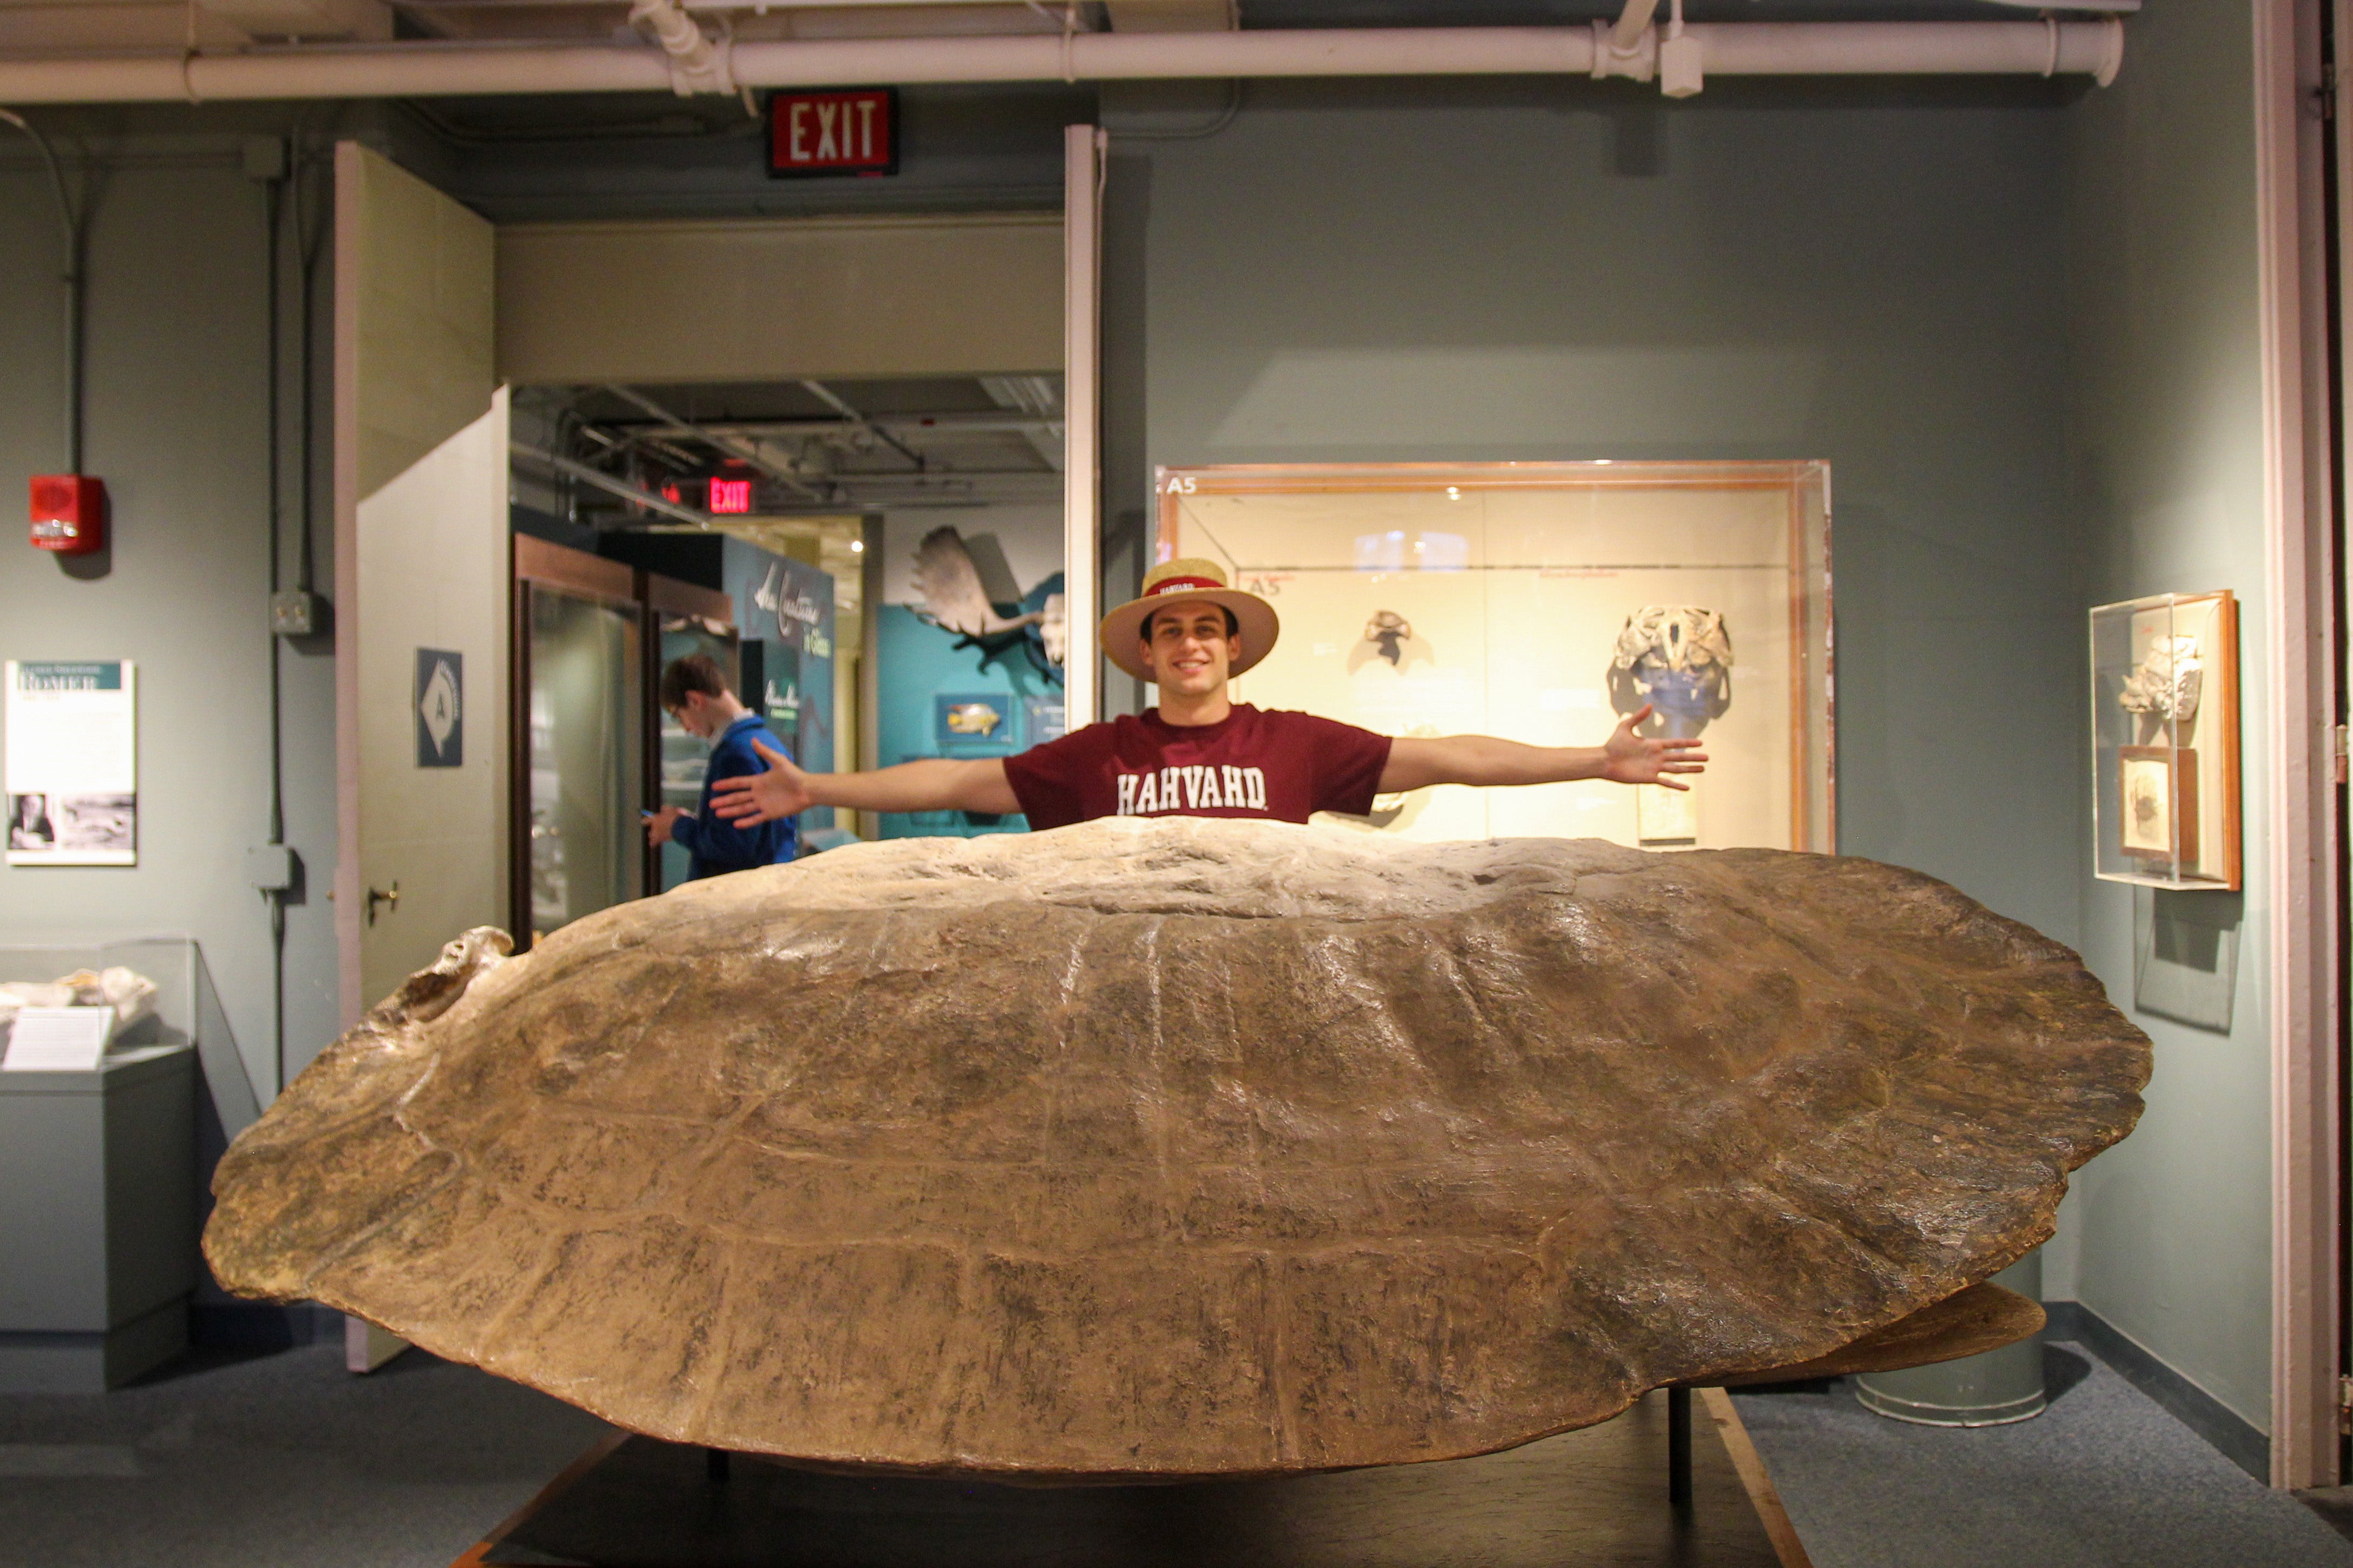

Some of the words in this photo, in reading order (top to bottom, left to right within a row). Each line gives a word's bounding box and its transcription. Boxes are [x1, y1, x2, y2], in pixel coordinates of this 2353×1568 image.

[790, 100, 877, 161] EXIT
[710, 477, 750, 513] EXIT
[1167, 477, 1196, 494] A5
[1159, 582, 1195, 595] HARVARD
[1117, 764, 1267, 816] HAHVAHD
